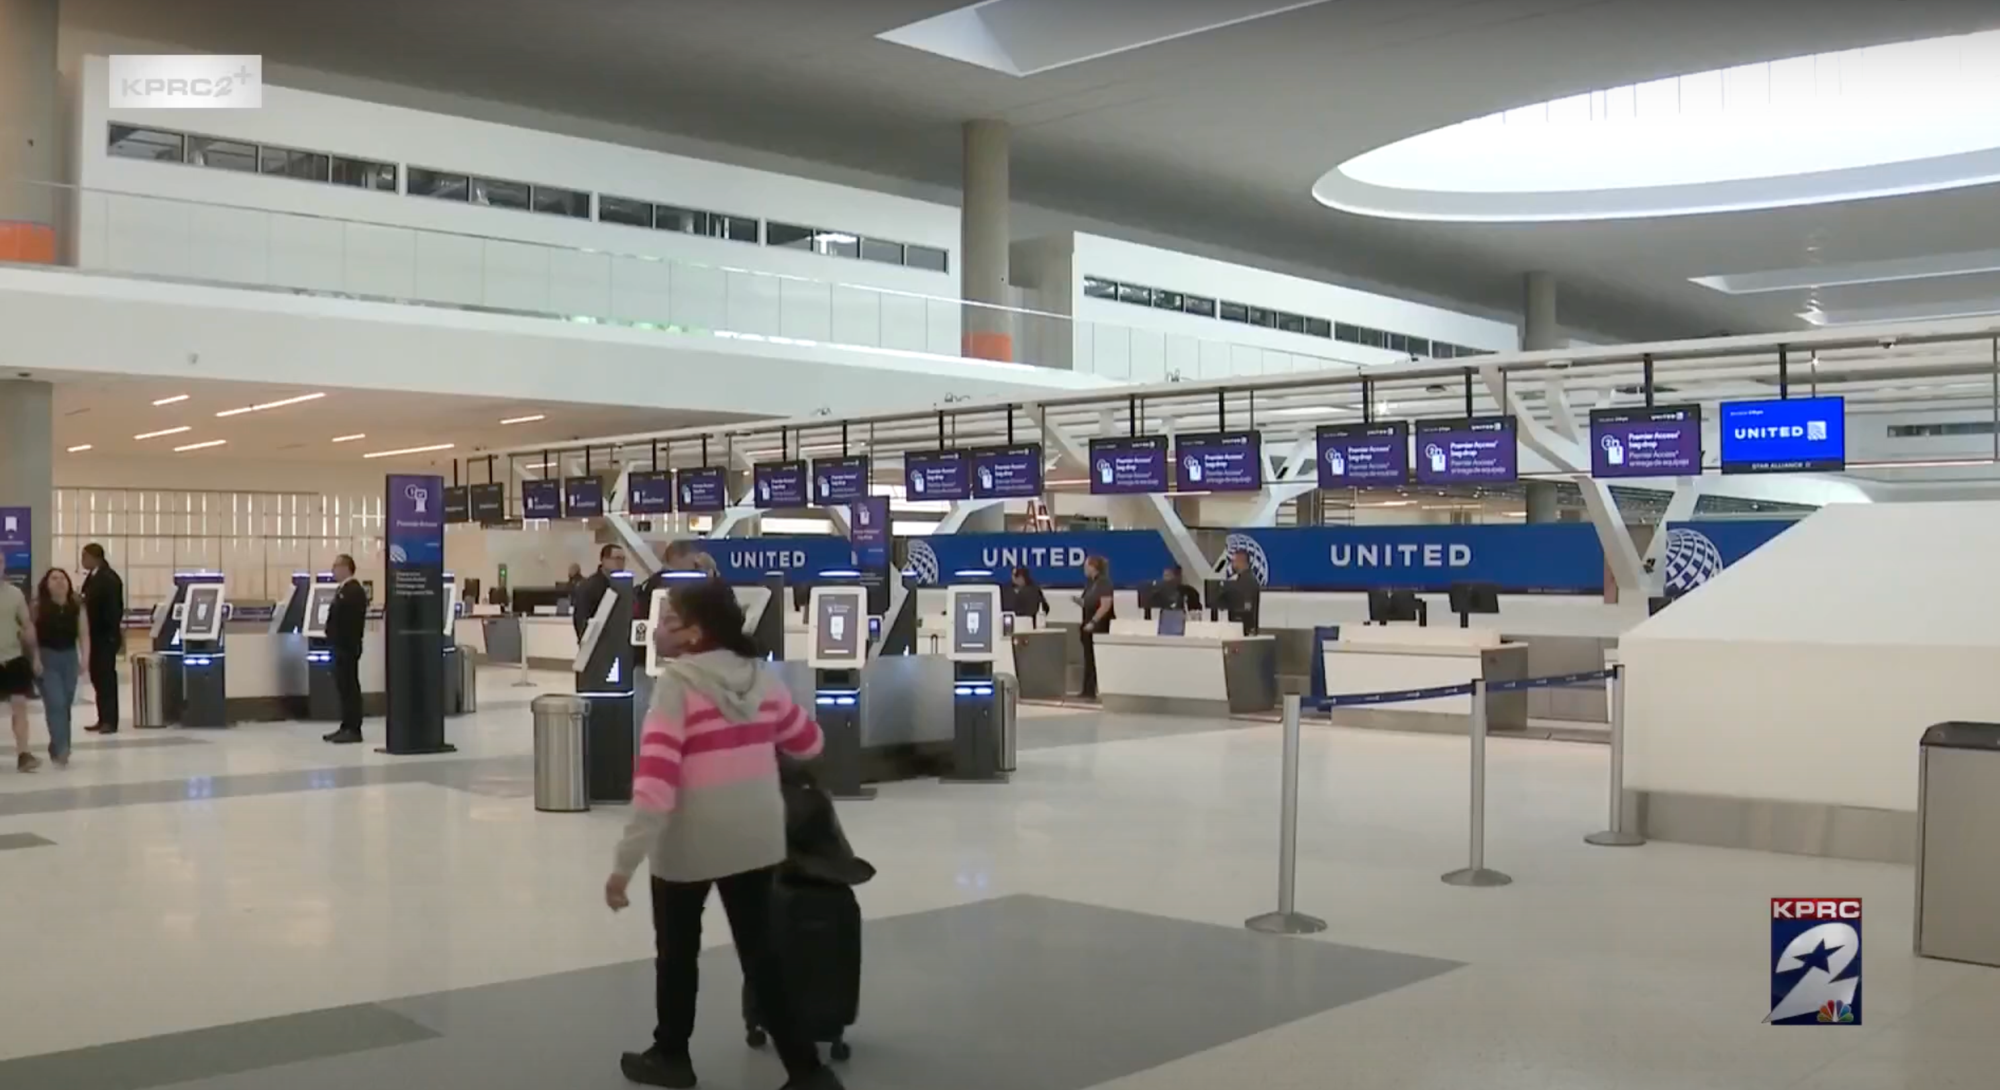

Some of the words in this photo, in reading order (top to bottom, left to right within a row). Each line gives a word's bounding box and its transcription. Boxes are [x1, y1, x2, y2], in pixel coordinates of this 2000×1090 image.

[1735, 426, 1803, 439] UNITED
[730, 551, 806, 568] UNITED
[983, 547, 1085, 567] UNITED
[1331, 544, 1471, 567] UNITED
